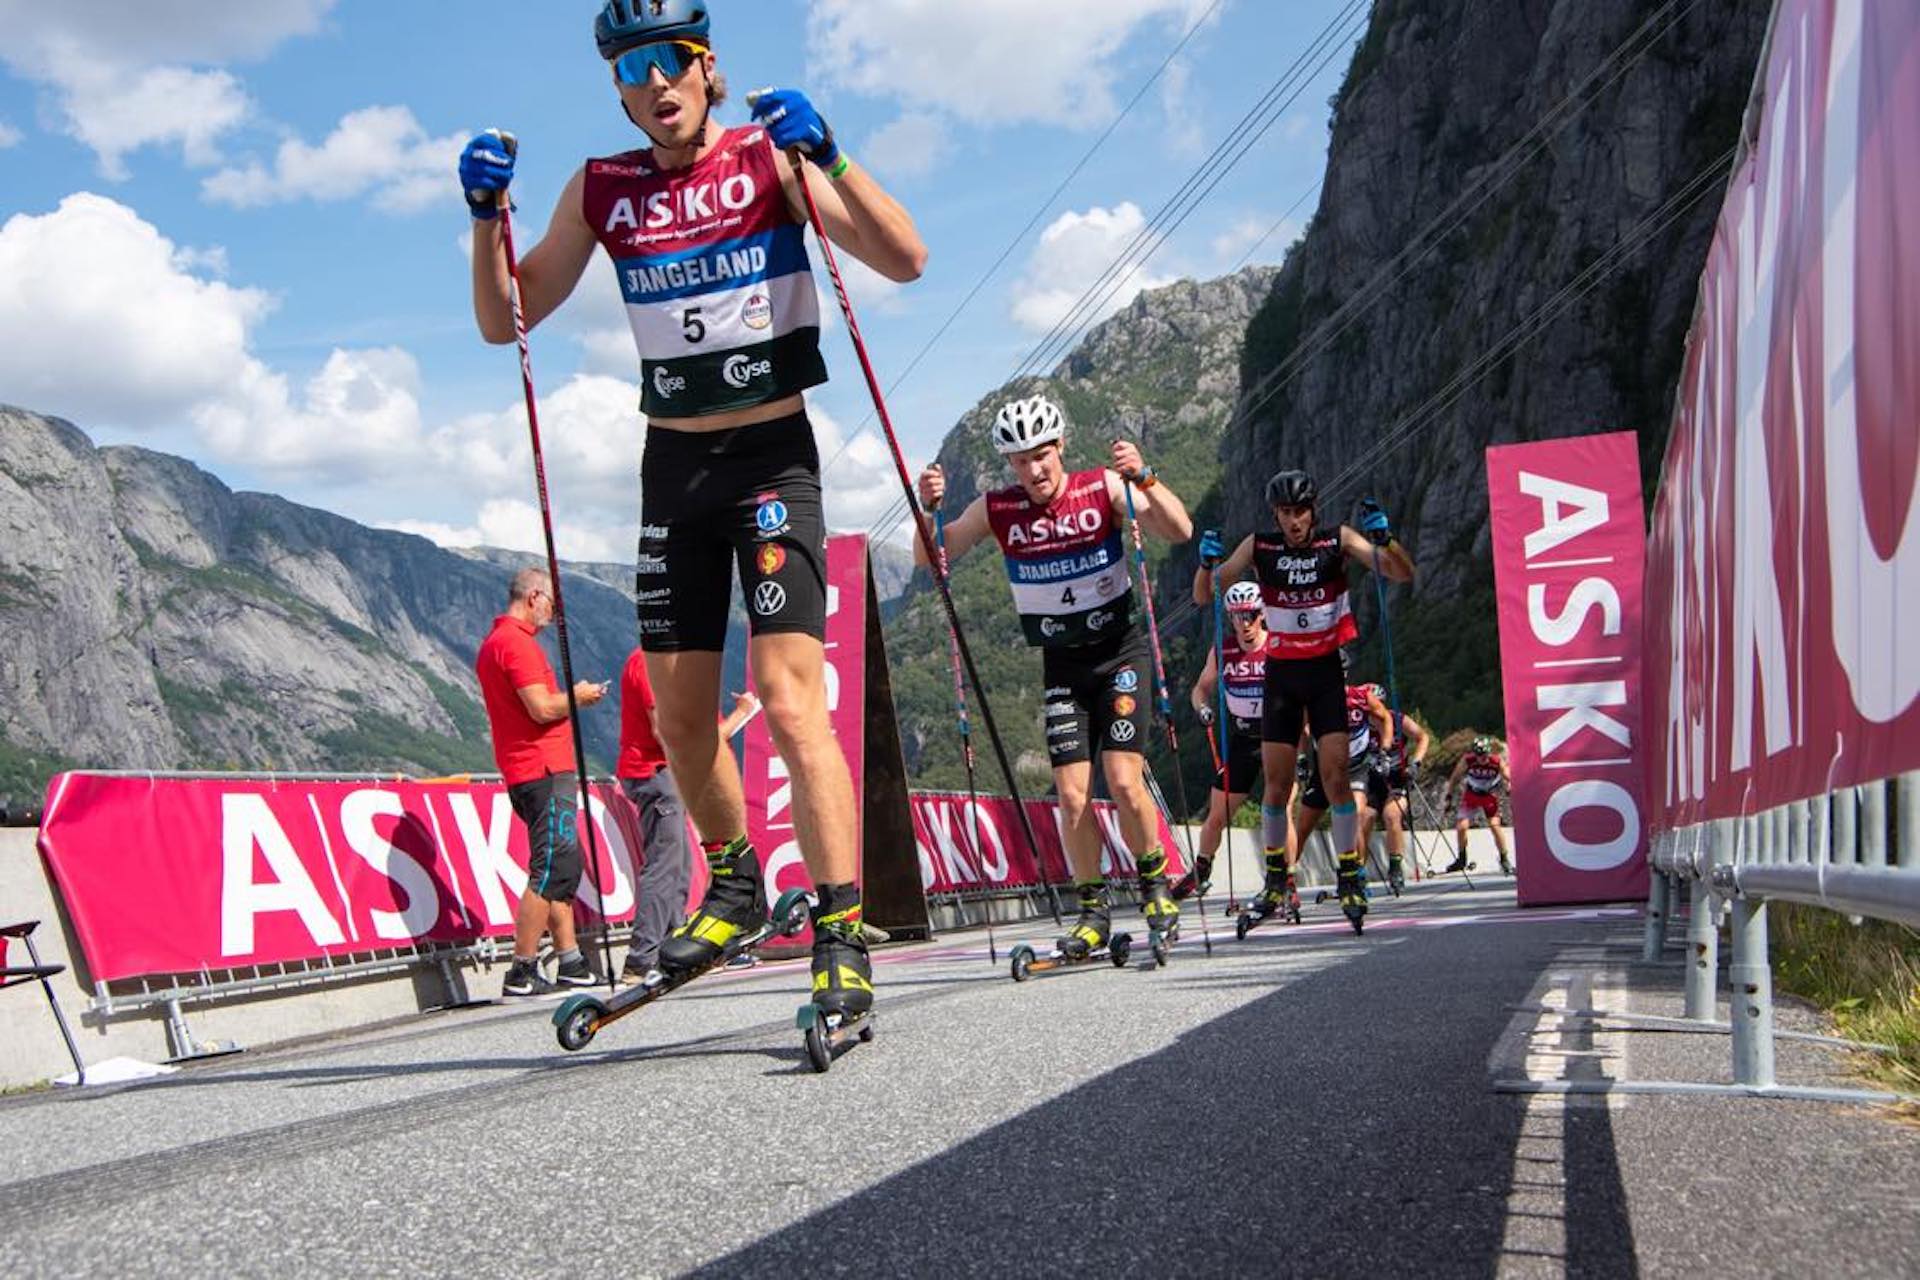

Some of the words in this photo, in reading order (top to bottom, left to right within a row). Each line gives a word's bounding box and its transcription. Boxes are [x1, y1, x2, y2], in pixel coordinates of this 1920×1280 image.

[683, 307, 705, 343] 5
[1018, 549, 1108, 579] STANGELAND
[1287, 571, 1318, 585] Hus
[1062, 588, 1076, 606] 4
[1297, 613, 1308, 628] 6
[1223, 661, 1266, 676] ASK
[1249, 701, 1259, 714] 7
